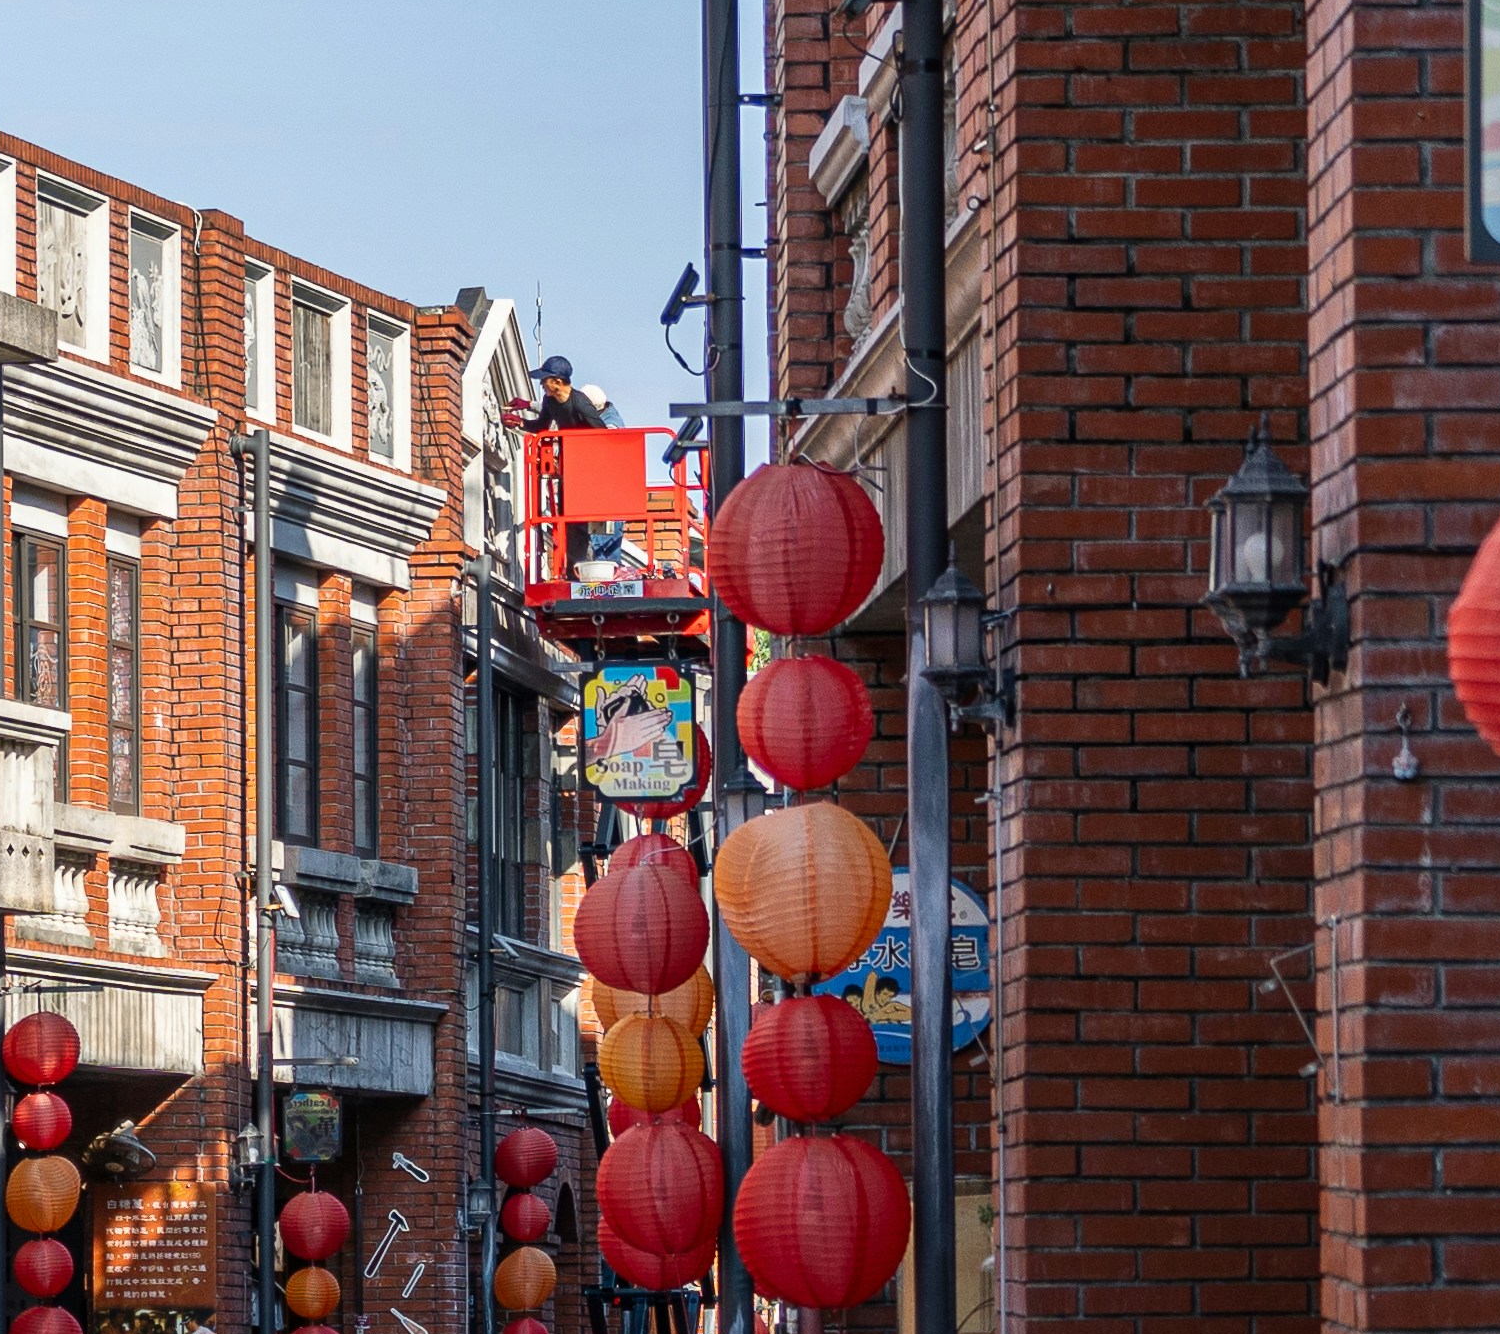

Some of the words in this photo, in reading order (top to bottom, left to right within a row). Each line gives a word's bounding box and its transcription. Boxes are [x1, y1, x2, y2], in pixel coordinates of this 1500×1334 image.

[596, 757, 644, 775] Soap
[649, 738, 688, 778] 皂
[613, 778, 671, 791] Making
